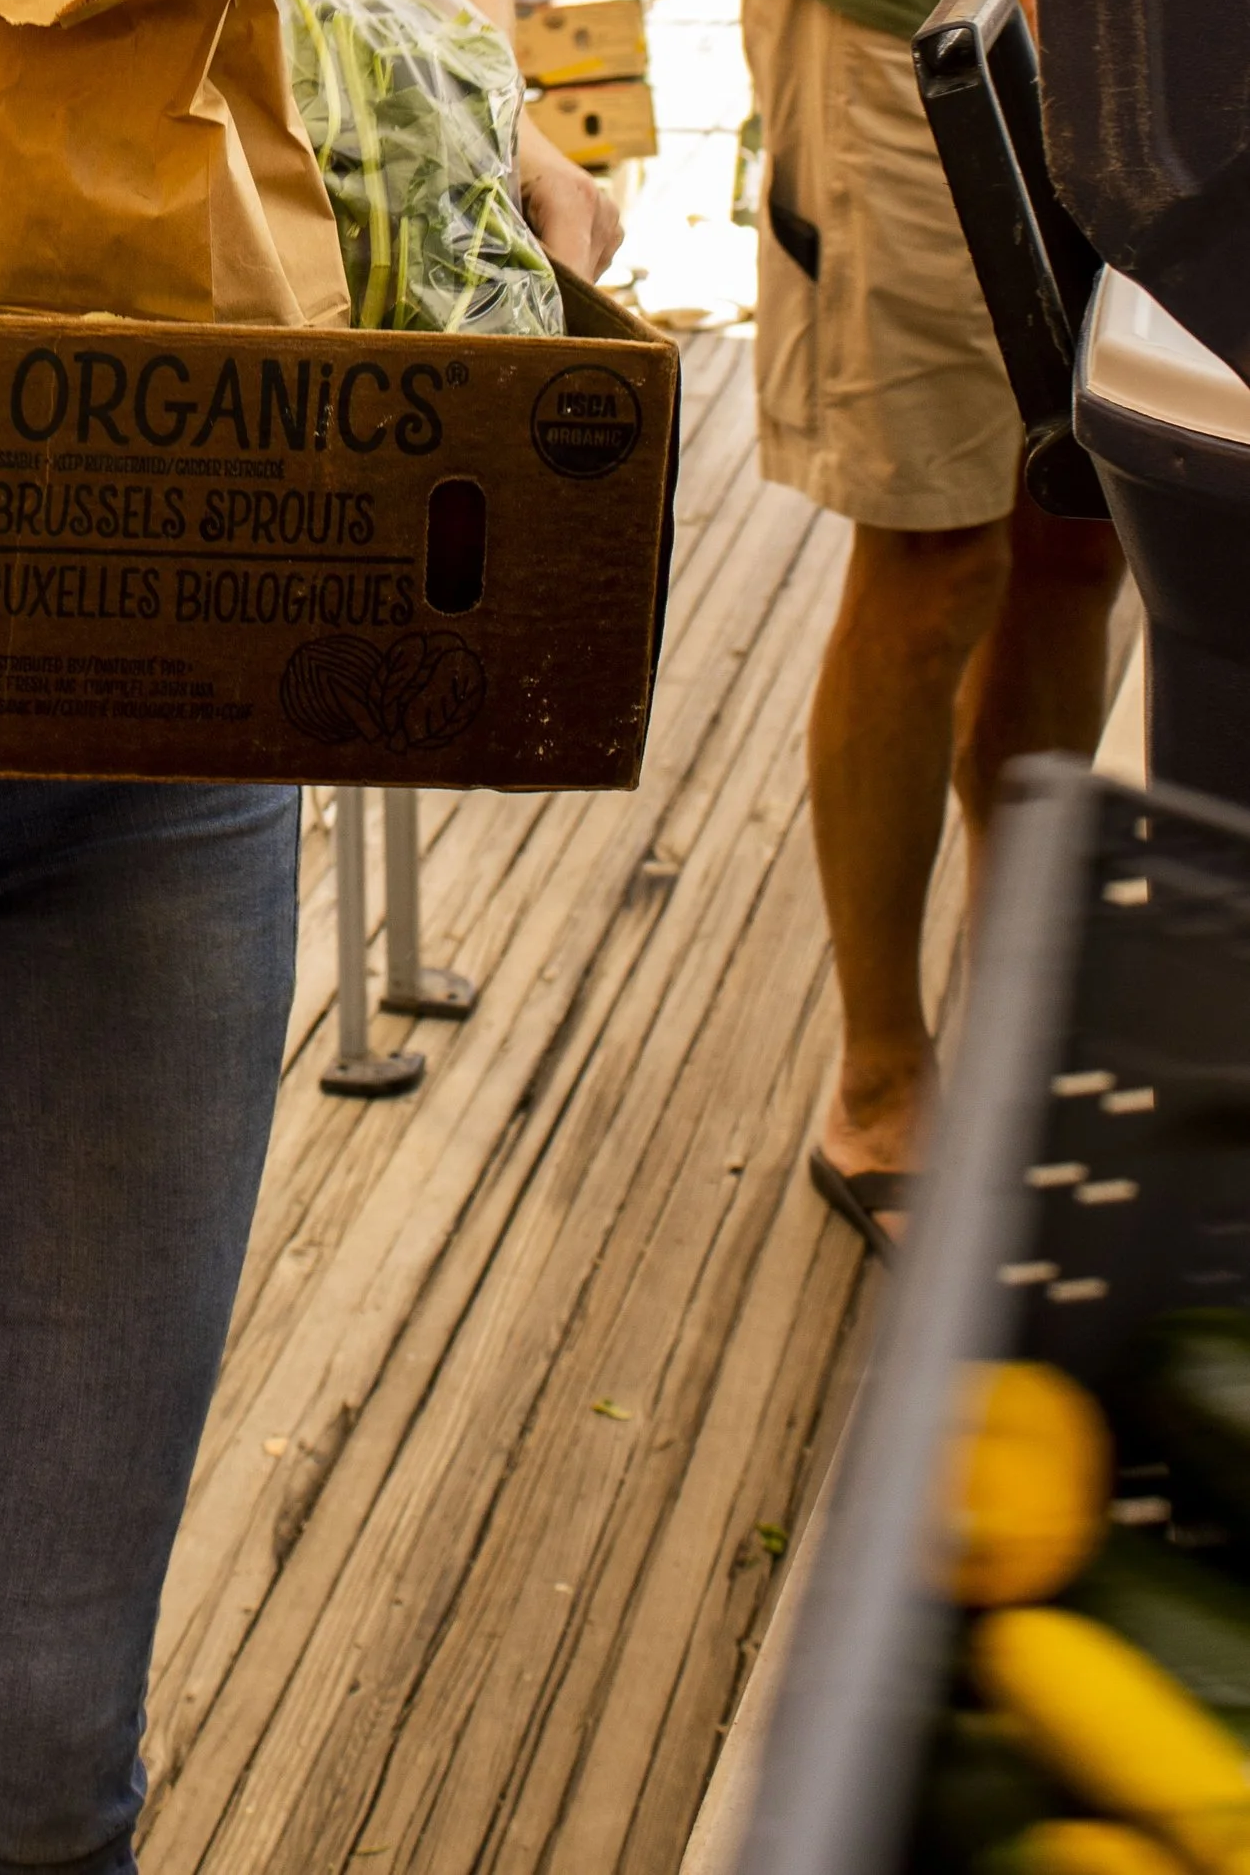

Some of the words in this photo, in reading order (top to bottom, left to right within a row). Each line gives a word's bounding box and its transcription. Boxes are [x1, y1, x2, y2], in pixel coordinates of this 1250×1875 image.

[557, 391, 617, 418] USDA
[546, 427, 623, 447] ORGANIC
[199, 488, 375, 547] SPROUTS
